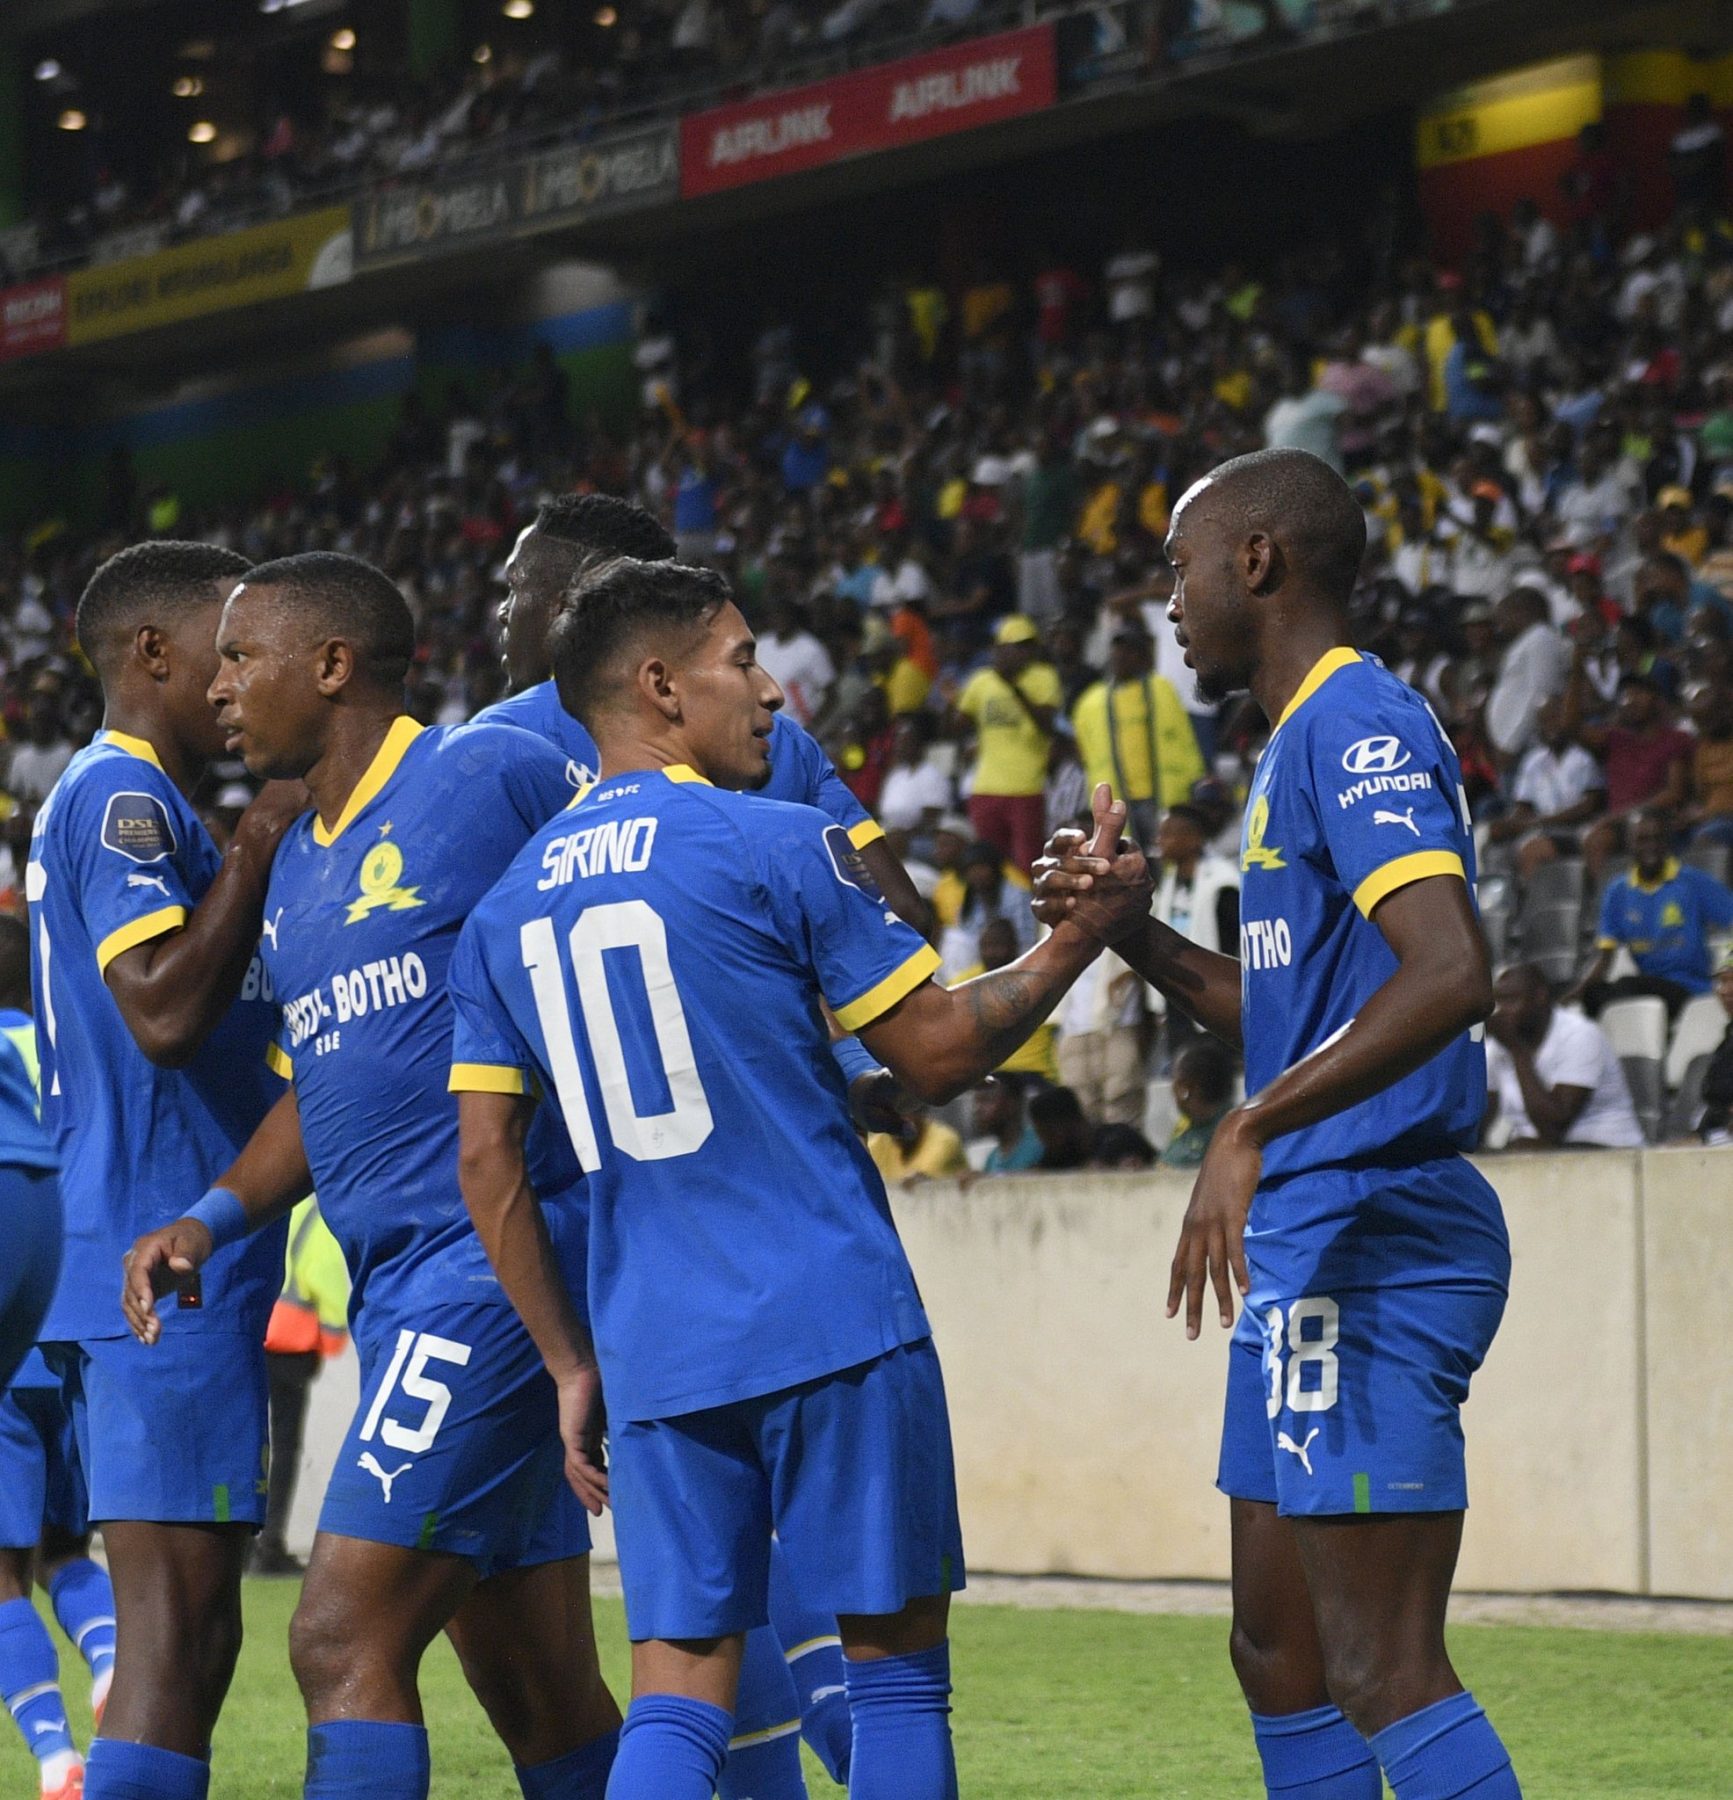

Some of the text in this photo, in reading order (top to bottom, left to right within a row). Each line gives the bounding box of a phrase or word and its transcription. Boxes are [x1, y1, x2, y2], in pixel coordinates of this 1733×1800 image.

[889, 57, 1022, 122] AIRLINK
[711, 104, 833, 167] AIRLINK
[1338, 772, 1432, 810] HYUNDAI
[537, 817, 658, 891] SIRINO
[520, 899, 715, 1174] 10
[359, 1328, 472, 1454] 15
